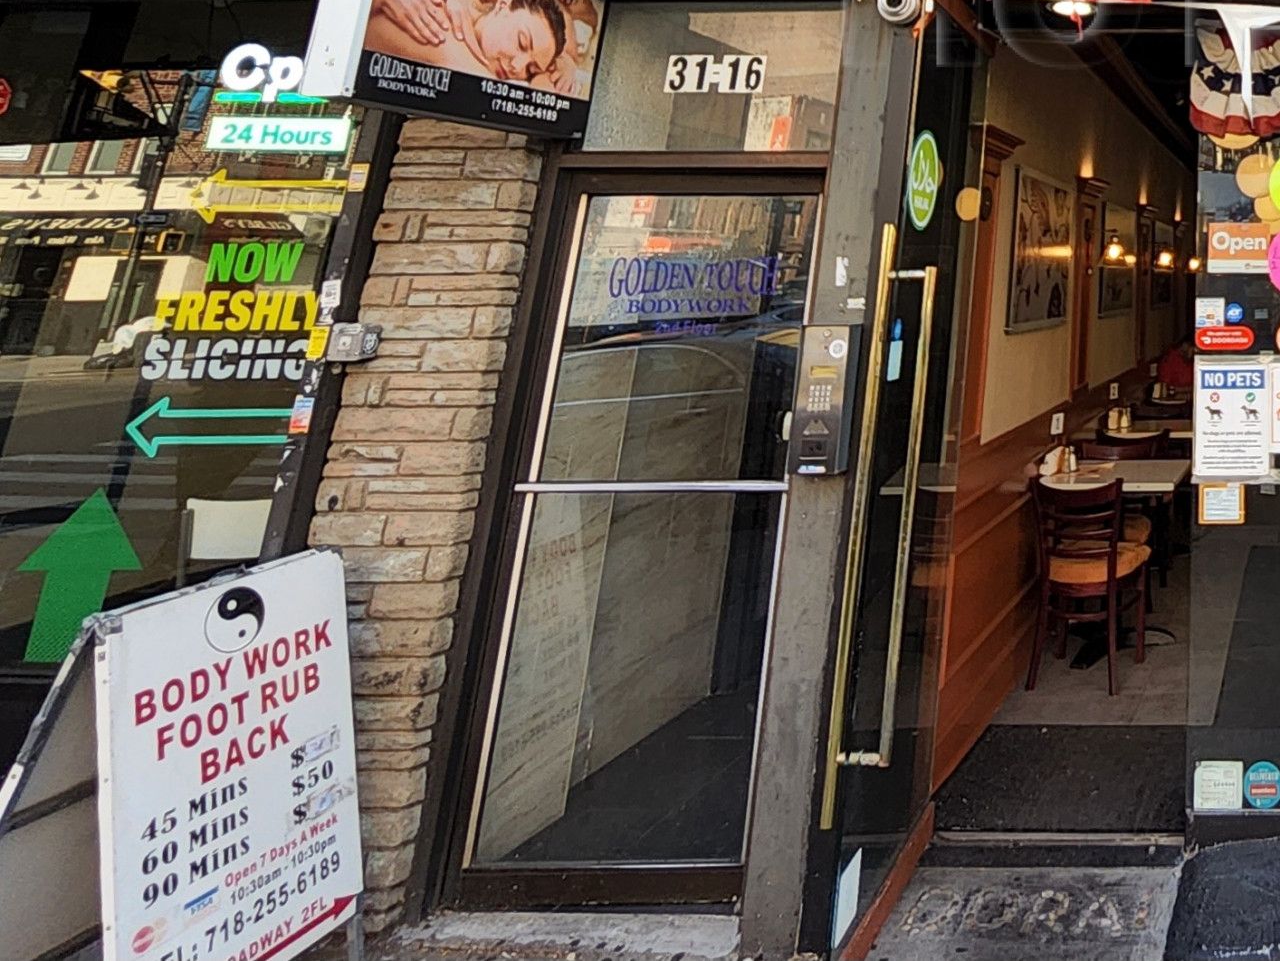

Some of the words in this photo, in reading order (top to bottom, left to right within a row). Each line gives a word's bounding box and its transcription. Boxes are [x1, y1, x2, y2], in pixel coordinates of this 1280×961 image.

[369, 53, 413, 80] GOLDEN
[415, 66, 451, 93] TOUCH
[377, 79, 437, 99] BODYWORK
[668, 56, 764, 91] 31-16
[481, 80, 508, 97] 10:30
[509, 88, 524, 101] am
[531, 90, 556, 108] 10:00
[556, 99, 570, 111] pm
[491, 99, 557, 122] (718)-255-6189
[220, 123, 255, 144] 24
[260, 124, 333, 146] Hours
[206, 242, 304, 283] NOW
[1211, 231, 1267, 255] Open
[609, 257, 698, 298] GOLDEN
[707, 256, 779, 296] TOUCH
[154, 291, 320, 332] FRESHLY
[627, 298, 751, 316] BODYWORK
[141, 337, 308, 381] SLICING
[1204, 372, 1224, 387] NO
[1226, 372, 1262, 387] PETS
[135, 656, 234, 727] BODY
[243, 618, 333, 680] WORK
[156, 690, 250, 762] FOOT
[260, 662, 321, 715] RUB
[200, 712, 290, 786] BACK
[291, 760, 334, 797] $50
[141, 807, 178, 844] 45
[188, 776, 249, 823] Mins
[141, 838, 179, 876] 60
[188, 805, 250, 854] Mins
[224, 861, 258, 889] Open
[260, 852, 270, 868] 7
[270, 839, 298, 863] Days
[299, 831, 308, 846] A
[308, 813, 338, 838] Week
[142, 872, 179, 910] 90
[188, 835, 251, 886] Mins
[229, 867, 282, 906] 10:30am
[290, 834, 337, 869] 10:30pm
[204, 850, 341, 954] 718-255-6189
[301, 896, 328, 924] 2FL
